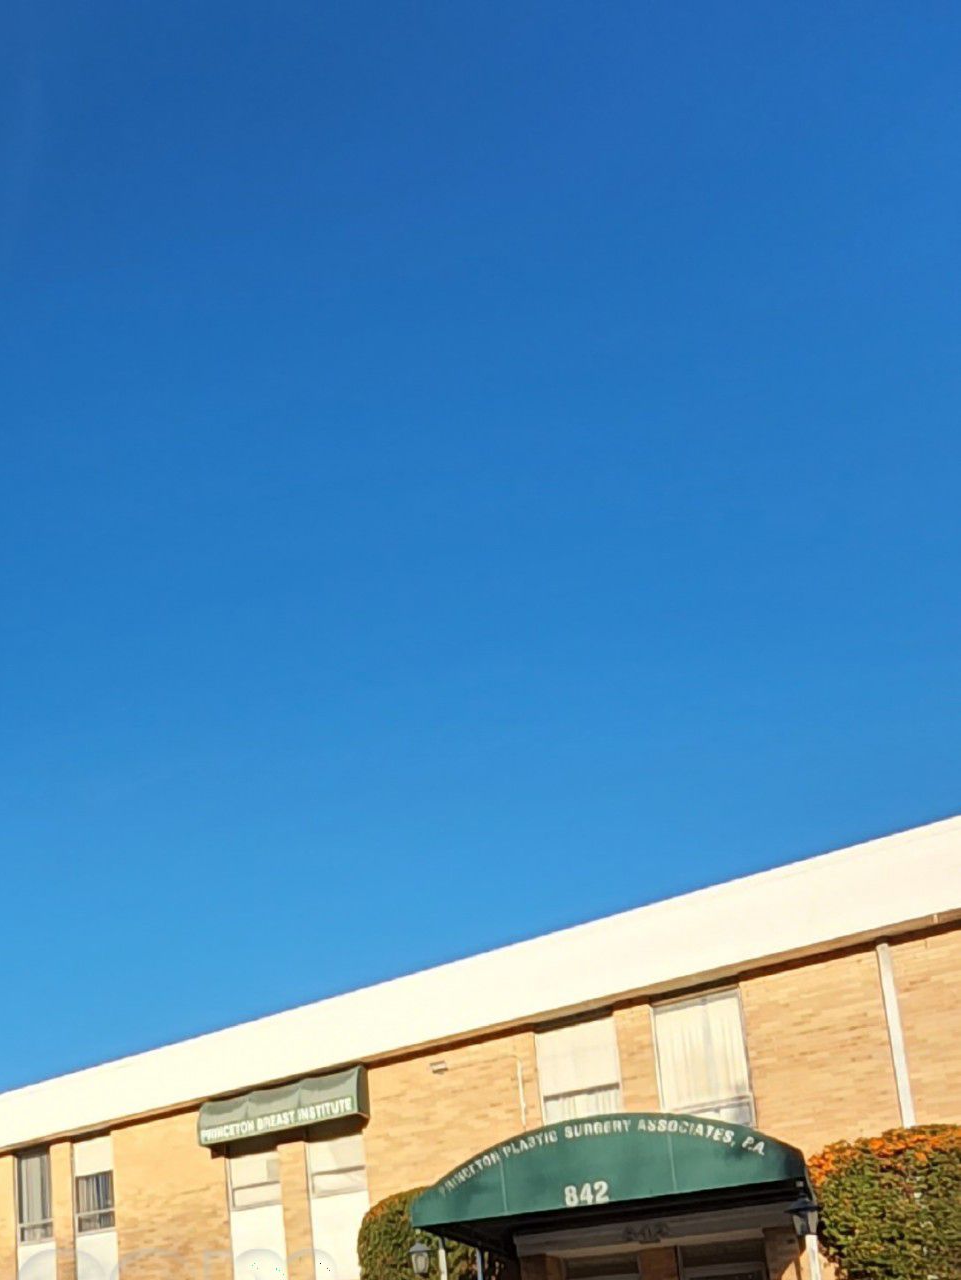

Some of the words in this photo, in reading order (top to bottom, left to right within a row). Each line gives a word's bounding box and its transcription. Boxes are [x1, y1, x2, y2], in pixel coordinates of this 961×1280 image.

[297, 1097, 353, 1122] INSTITUTE
[502, 1130, 558, 1158] PLASTIC
[564, 1119, 632, 1139] SURGERY
[564, 1180, 610, 1208] 842
